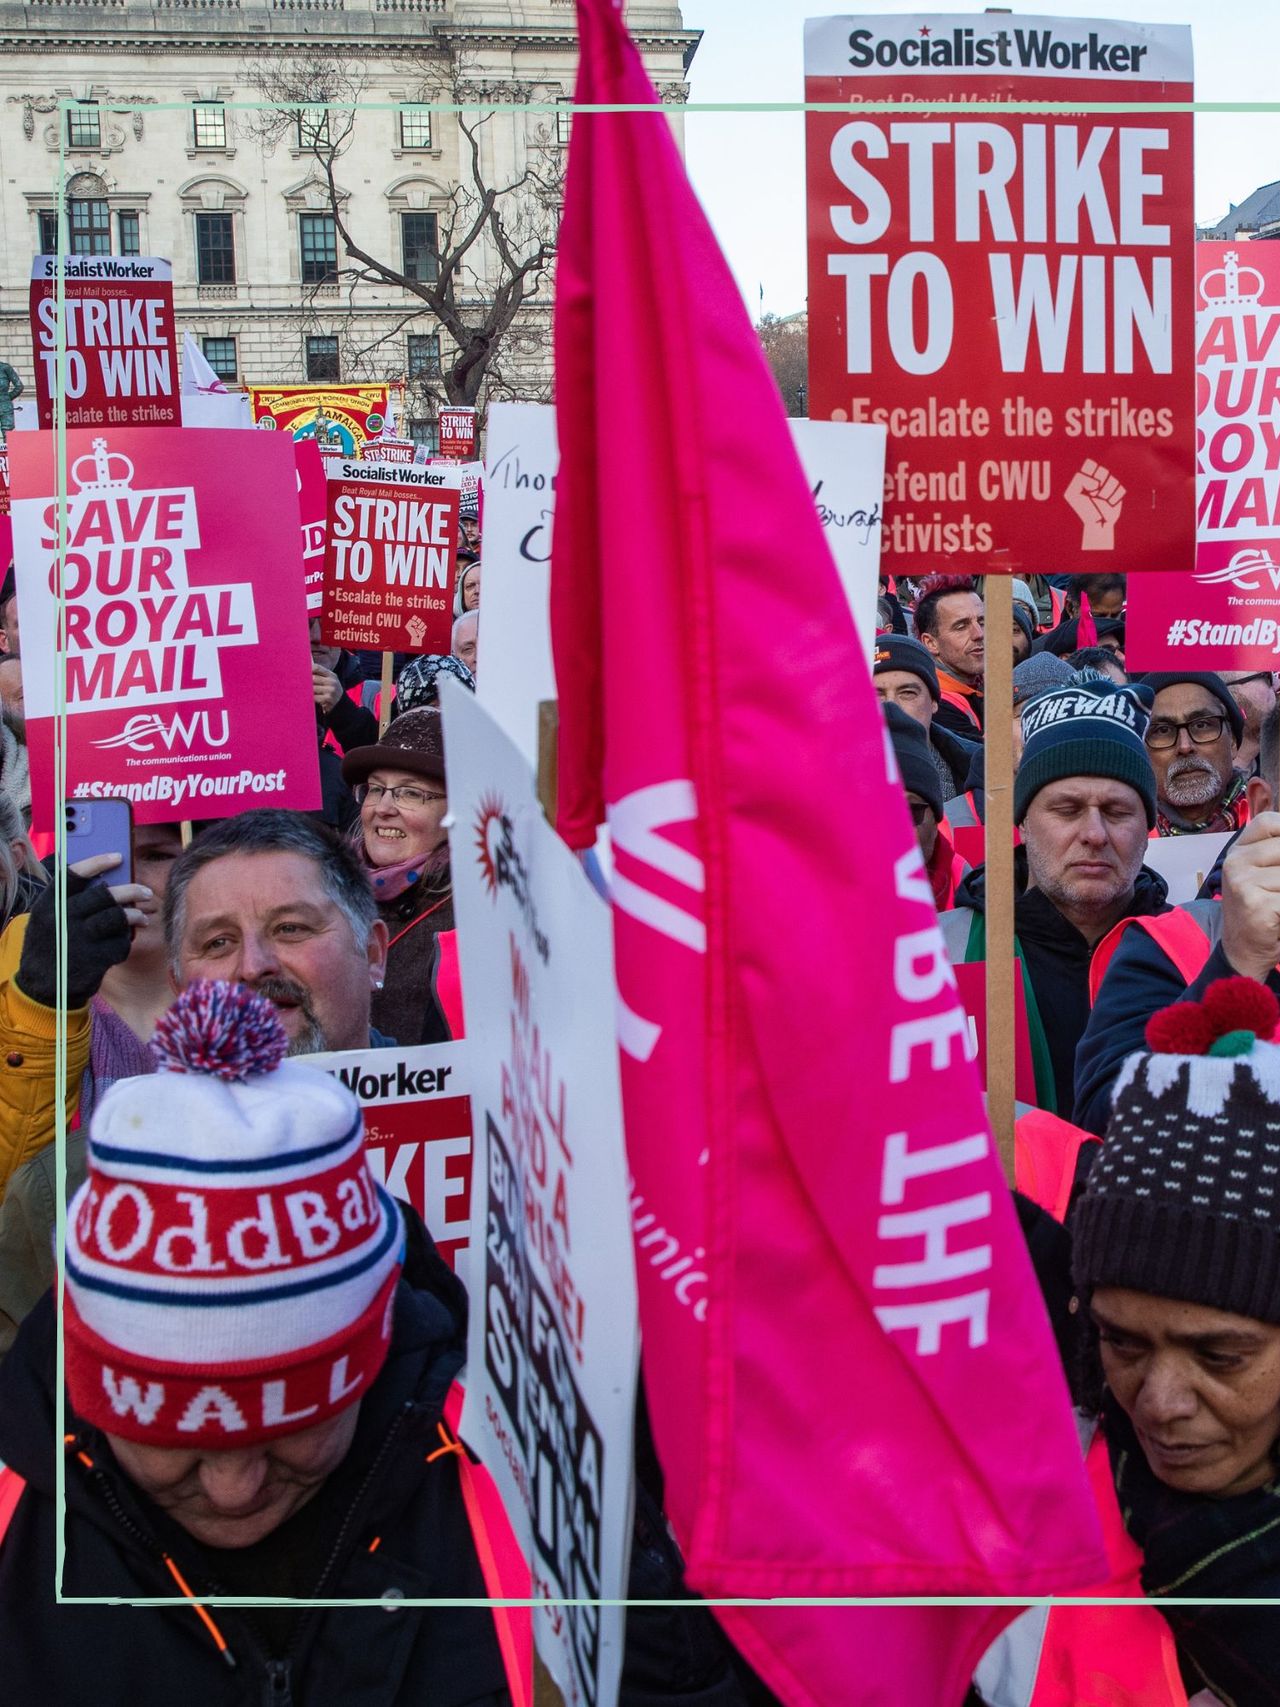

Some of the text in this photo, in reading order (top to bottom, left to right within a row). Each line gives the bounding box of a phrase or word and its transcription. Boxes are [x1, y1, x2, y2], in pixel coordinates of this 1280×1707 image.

[829, 120, 1171, 245] STRIKE
[62, 287, 82, 298] oyal
[83, 287, 99, 296] Mail
[38, 298, 168, 347] STRIKE
[827, 251, 1172, 375] TO WIN
[40, 350, 172, 399] TO WIN
[108, 405, 173, 422] the strikes
[325, 411, 363, 441] AMALGA
[441, 416, 473, 427] STRIKE
[441, 428, 473, 439] TO WIN
[1003, 397, 1052, 437] the
[1065, 398, 1174, 437] strikes
[381, 448, 411, 462] STRIKE
[342, 486, 357, 494] Beat
[359, 487, 378, 498] Royal
[378, 488, 393, 498] Mail
[884, 460, 1051, 502] efend CWU
[41, 494, 186, 549] SAVE
[333, 495, 452, 545] STRIKE
[880, 513, 992, 553] ctivists
[48, 549, 175, 600] OUR
[331, 538, 373, 583] TO
[384, 543, 449, 589] WIN
[335, 609, 401, 628] Defend CWU
[336, 588, 446, 611] Escalate the strikes
[1227, 597, 1243, 605] The
[57, 590, 244, 652] ROYAL
[334, 627, 380, 643] activists
[64, 644, 208, 703] MAIL
[89, 710, 230, 752] CWU
[126, 758, 141, 766] The
[142, 755, 208, 766] communications
[102, 1355, 363, 1433] WALL
